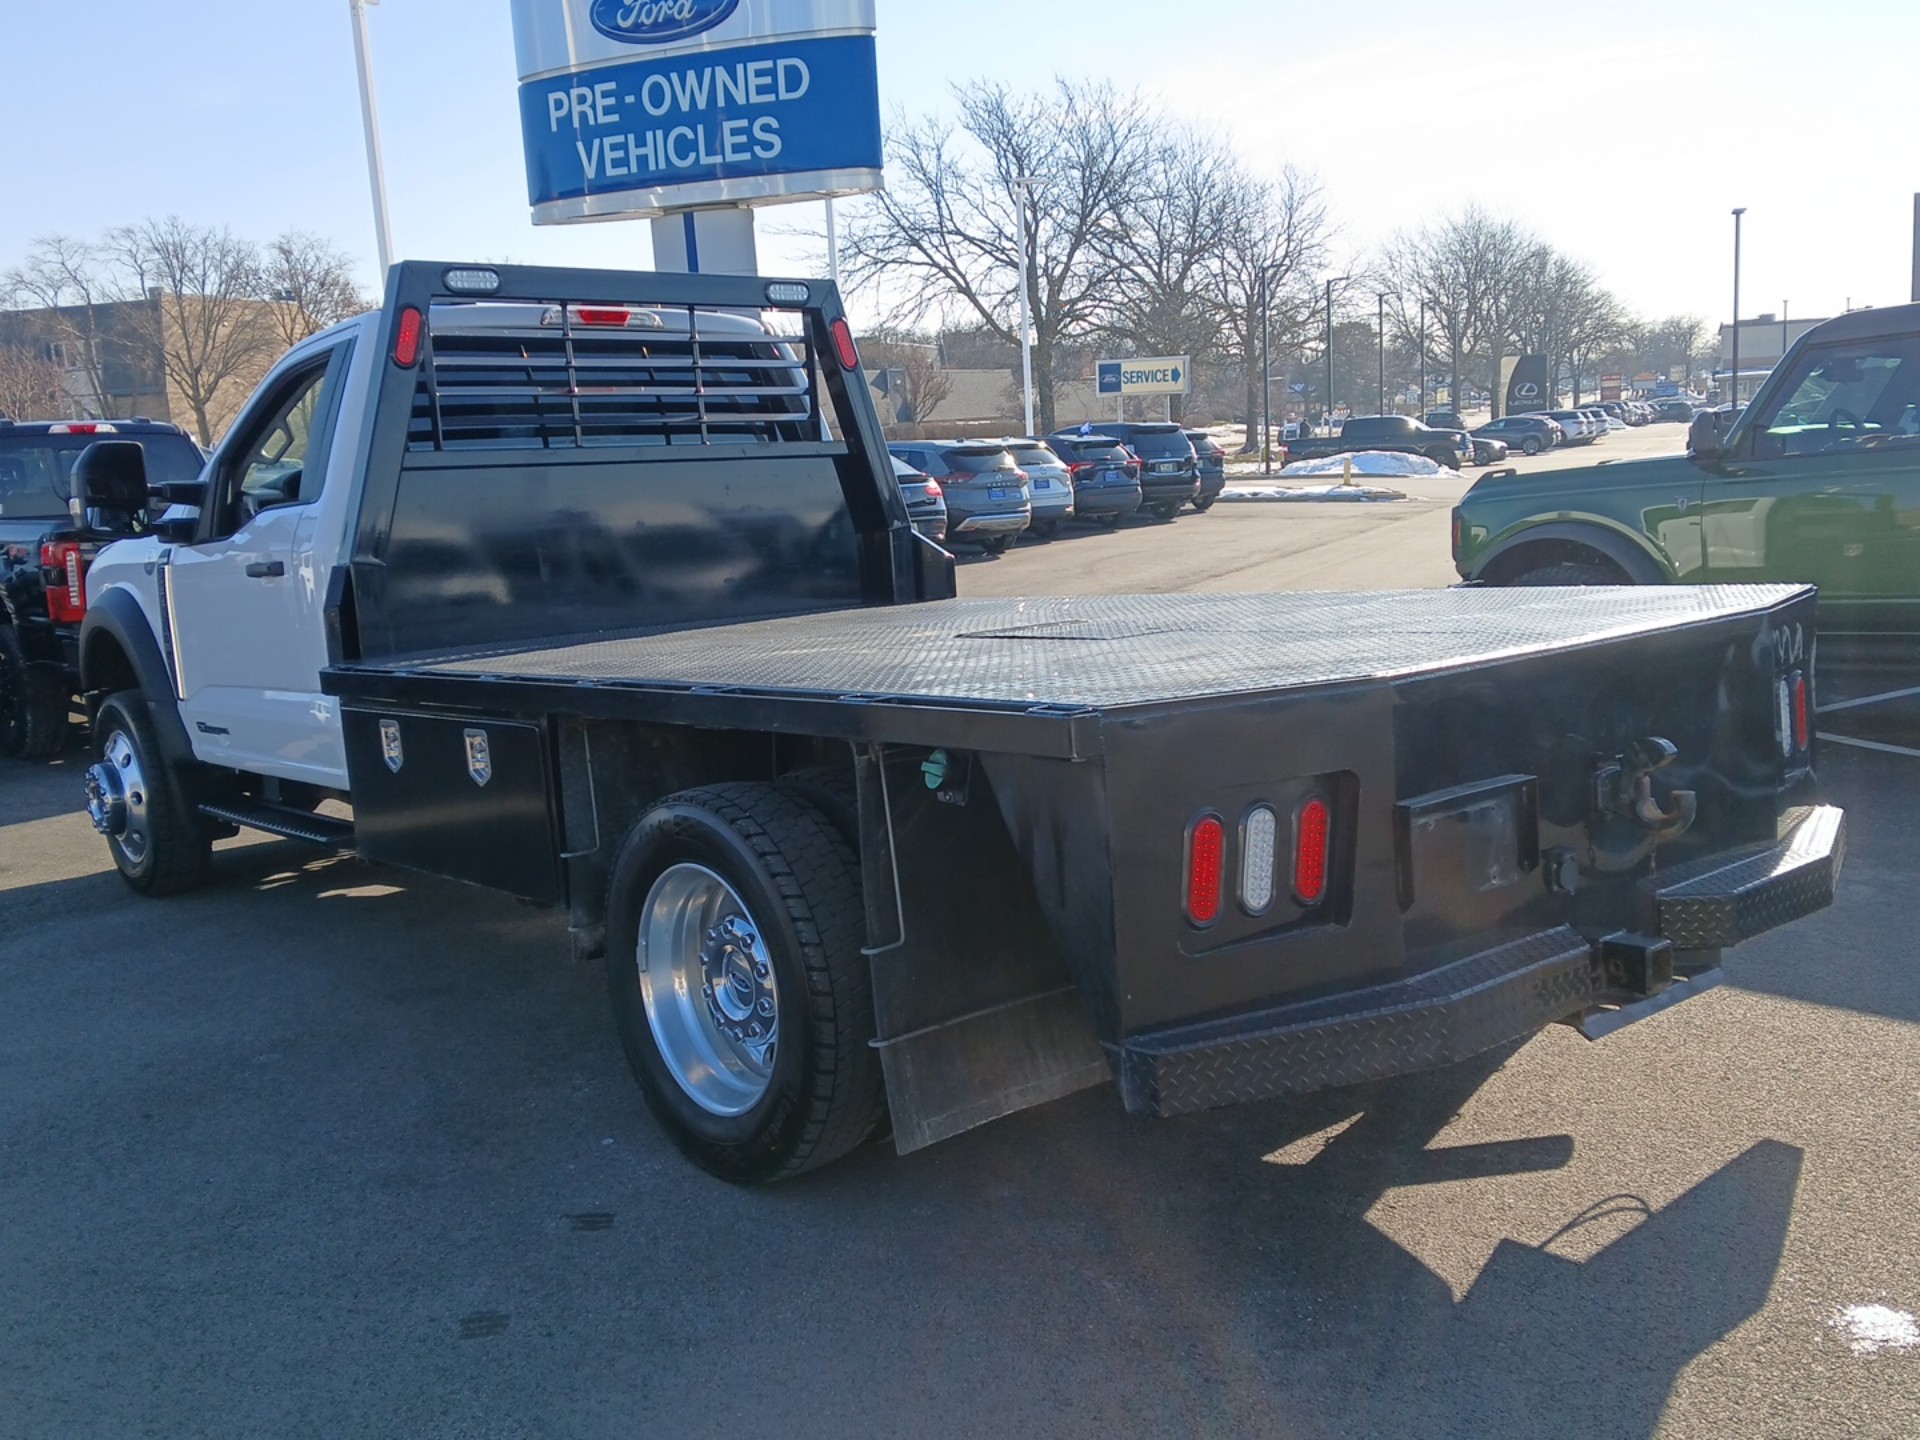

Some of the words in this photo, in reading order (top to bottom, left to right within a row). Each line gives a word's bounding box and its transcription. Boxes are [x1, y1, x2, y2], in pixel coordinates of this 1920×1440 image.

[548, 57, 810, 132] PRE-OWNED
[576, 116, 782, 180] VEHICLES
[1123, 368, 1169, 385] SERVICE
